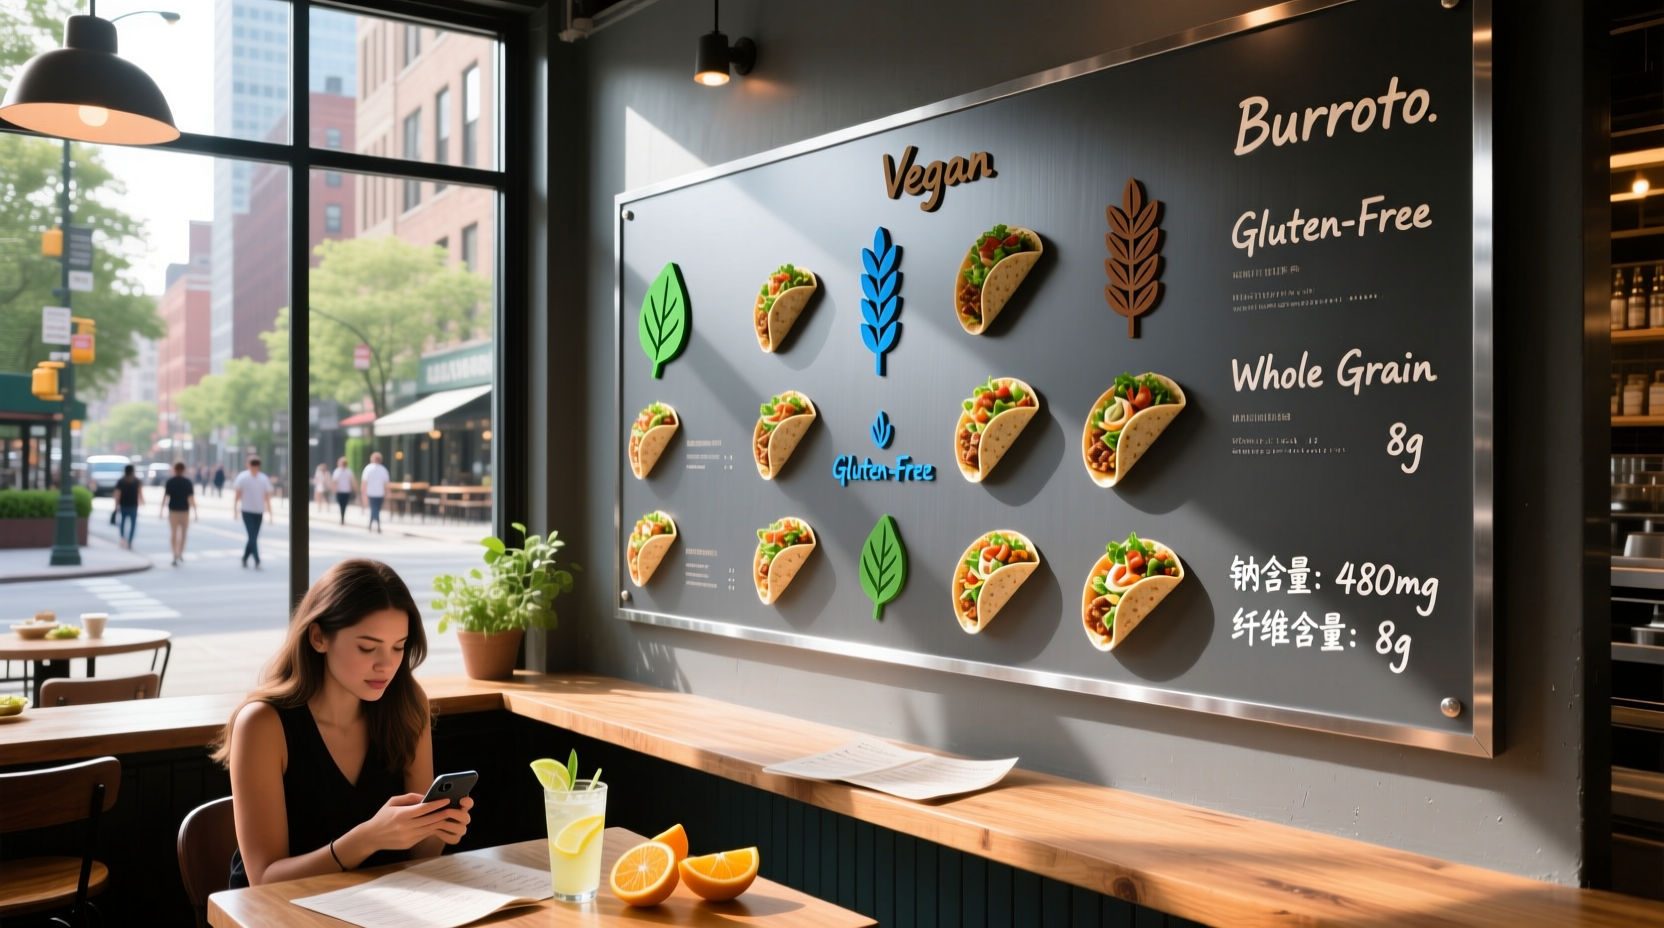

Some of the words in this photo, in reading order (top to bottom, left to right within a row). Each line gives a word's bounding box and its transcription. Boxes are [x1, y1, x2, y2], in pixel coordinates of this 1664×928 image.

[1234, 76, 1437, 156] Burroto.
[882, 145, 998, 213] Vegan
[1231, 195, 1433, 258] Gluten-Free
[1231, 350, 1324, 392] Whole
[1336, 348, 1438, 395] Grain
[832, 454, 936, 487] Gluten-Free
[1386, 422, 1424, 474] 8g
[1335, 561, 1439, 617] 480mg
[1375, 620, 1412, 674] 8g
